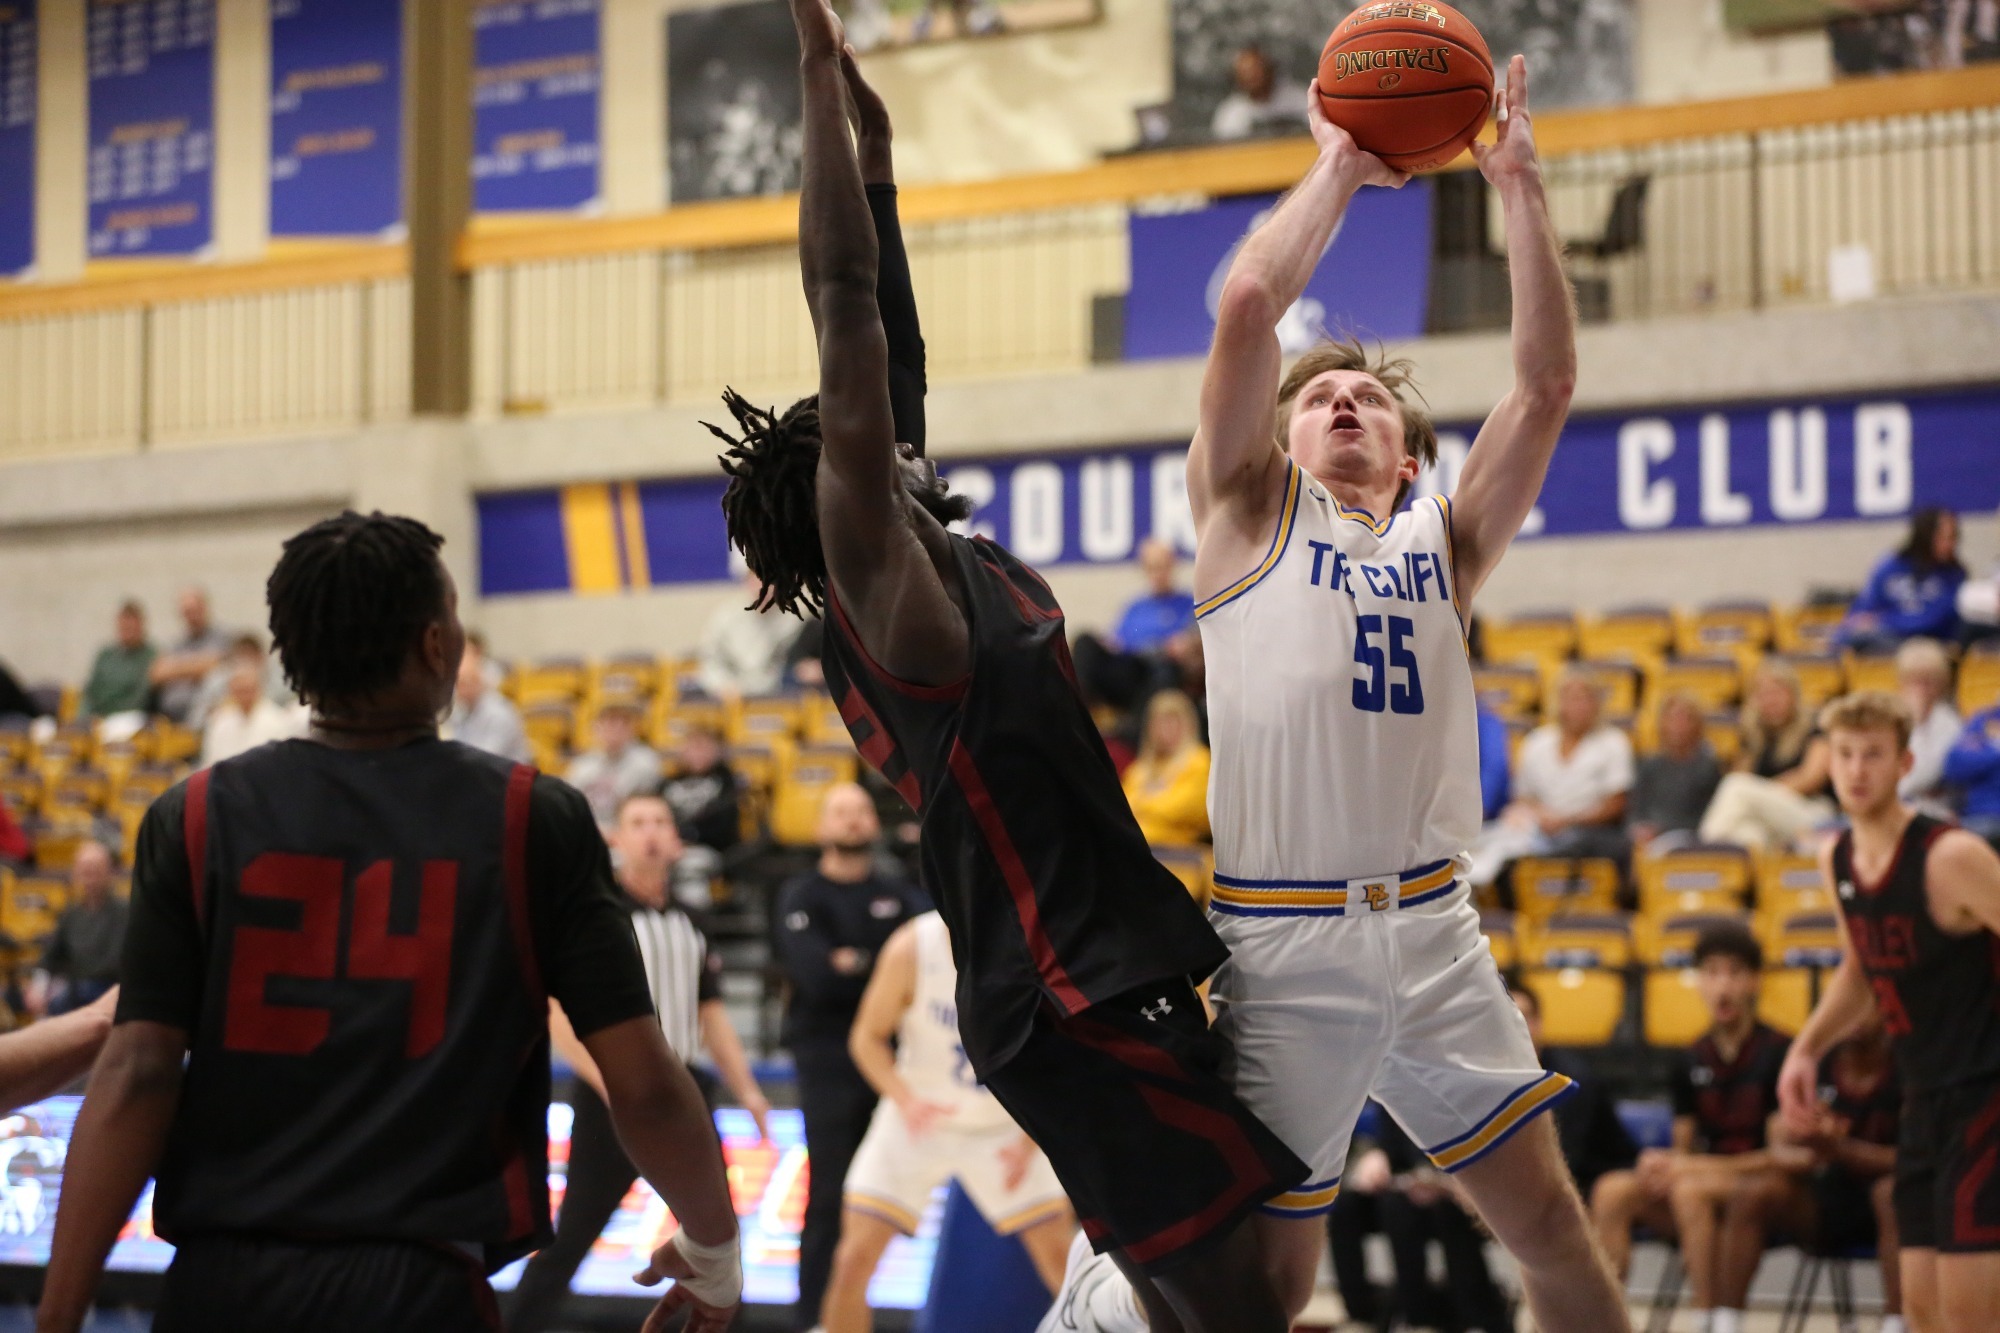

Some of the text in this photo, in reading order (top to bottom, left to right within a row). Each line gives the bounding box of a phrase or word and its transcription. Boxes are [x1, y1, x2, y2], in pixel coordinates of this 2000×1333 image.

[1336, 47, 1449, 81] SPALDING
[1617, 402, 1913, 530] CLUB
[1352, 615, 1425, 715] 55
[223, 852, 459, 1060] 24
